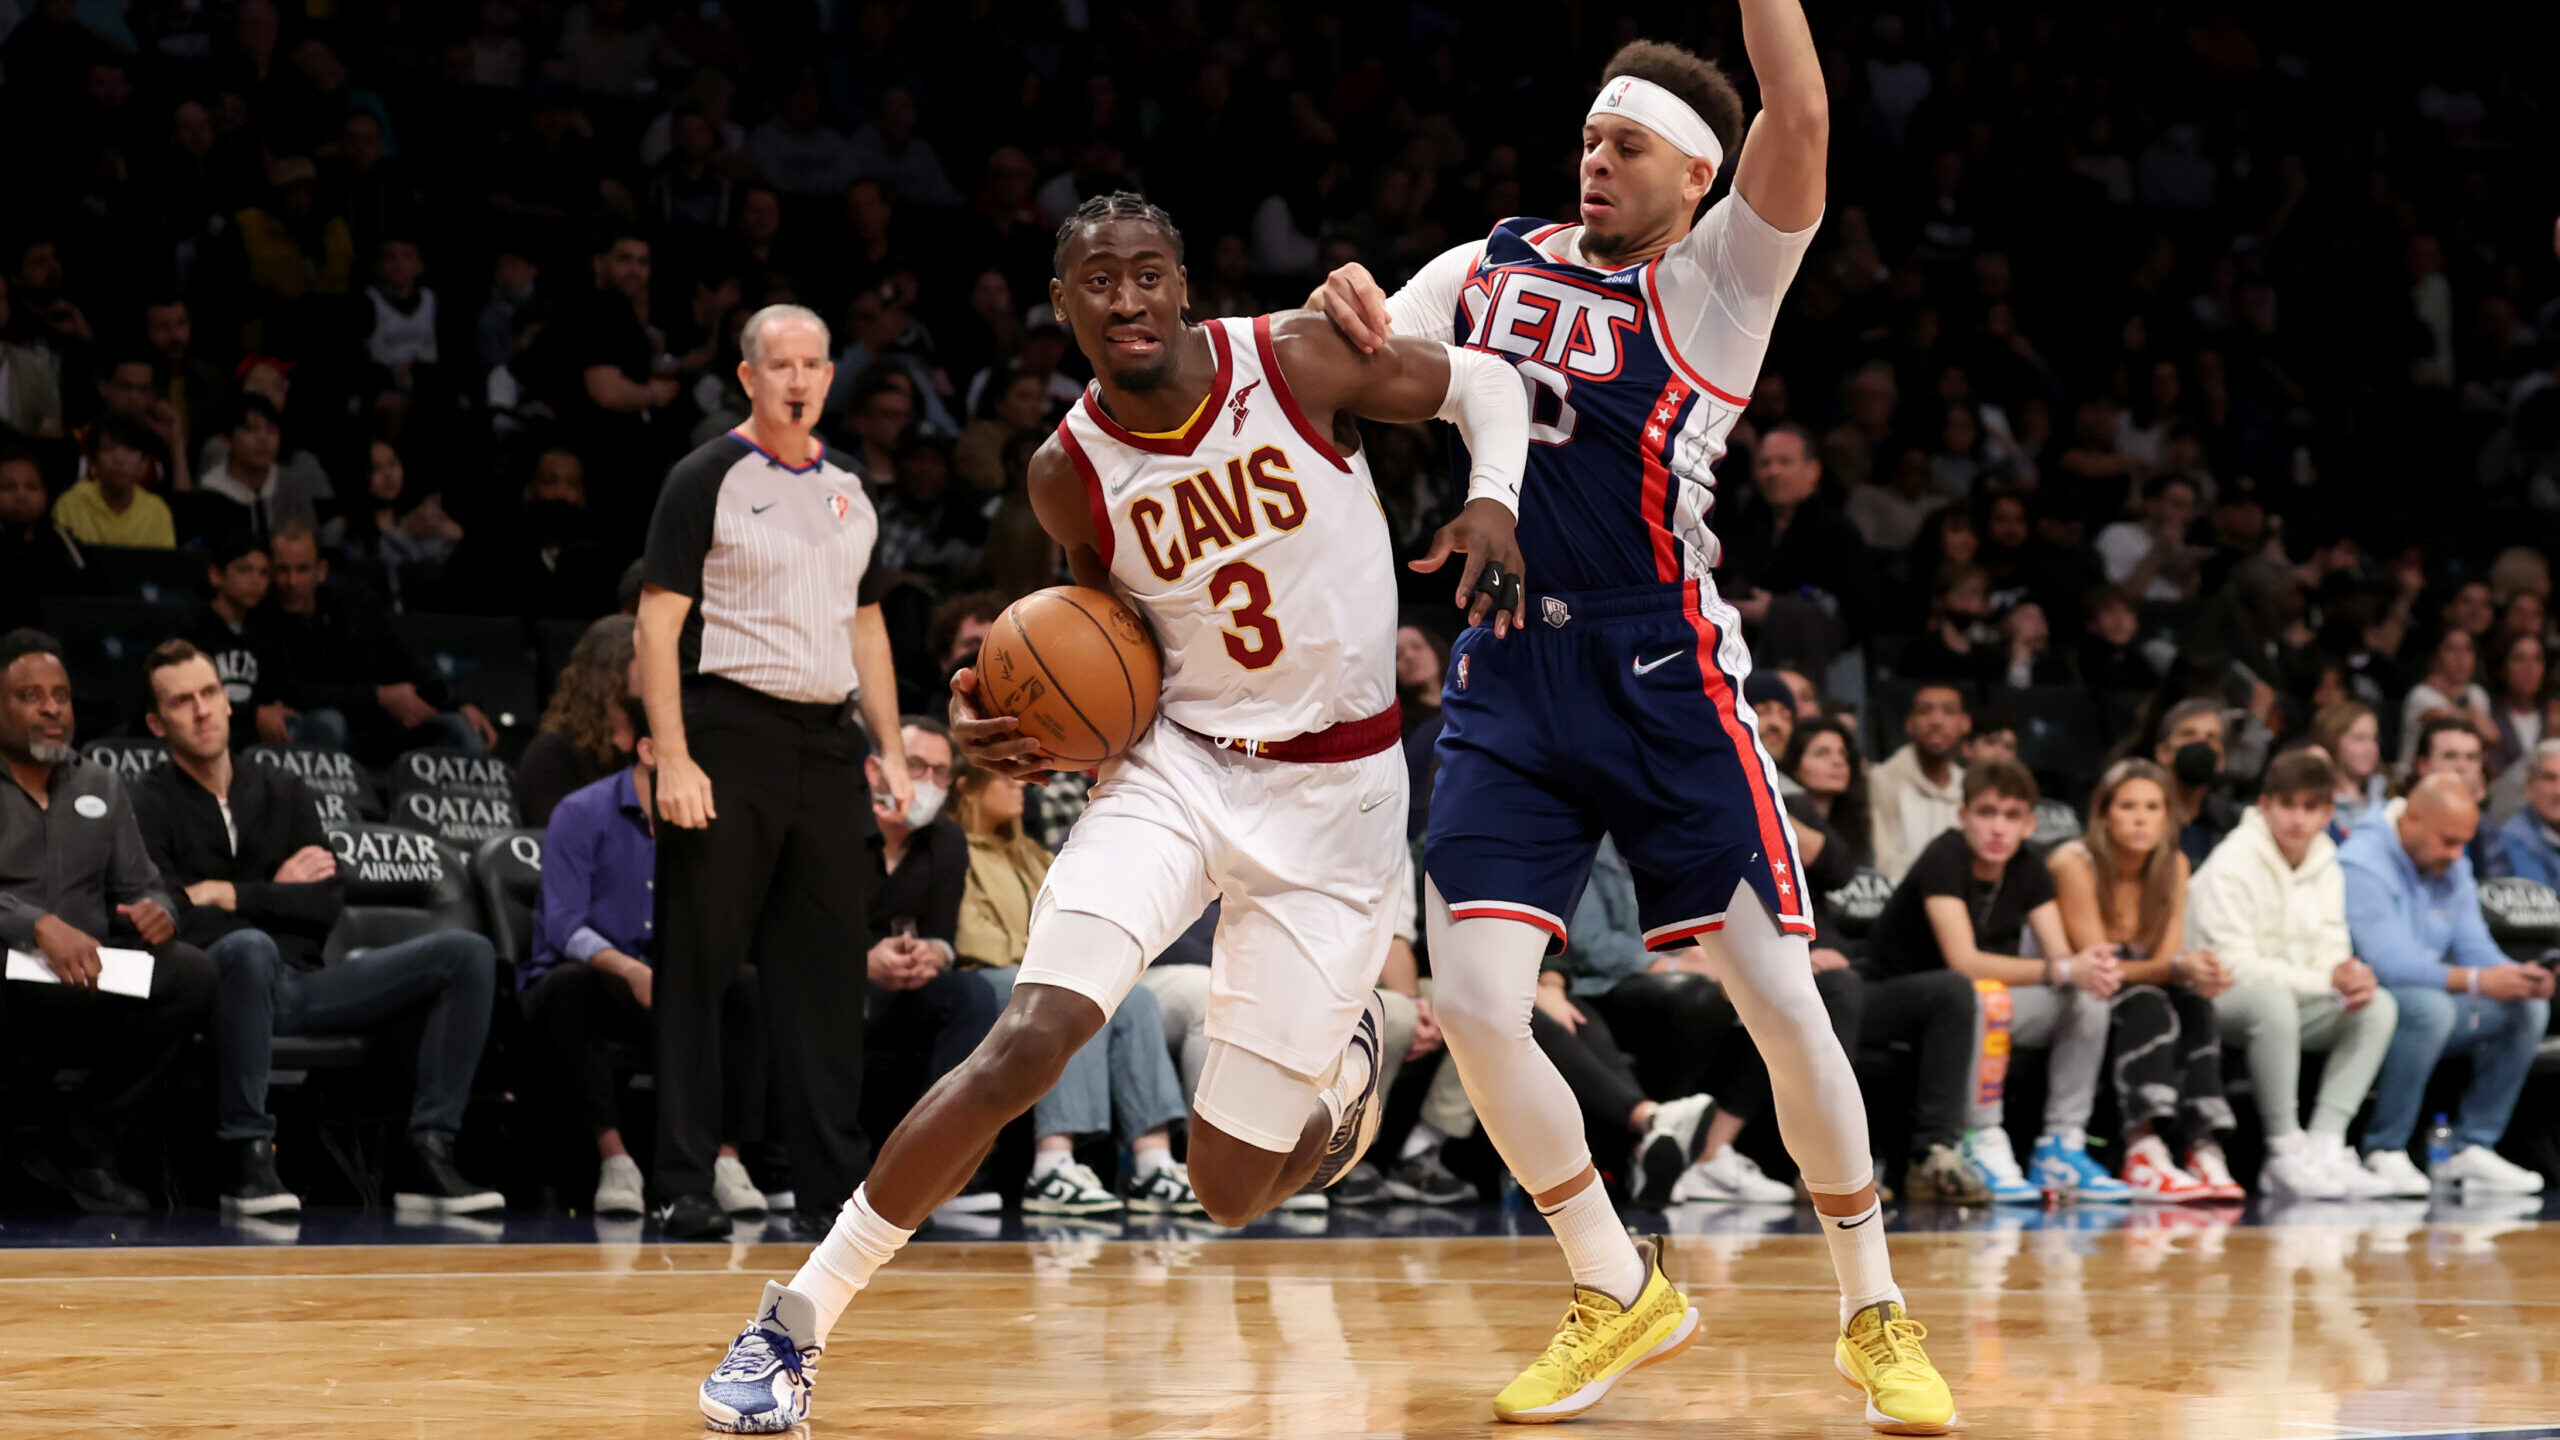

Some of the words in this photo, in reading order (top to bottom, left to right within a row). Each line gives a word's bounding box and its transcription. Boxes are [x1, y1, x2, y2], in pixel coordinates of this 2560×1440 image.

[1130, 445, 1308, 582] CAVS
[1208, 560, 1286, 672] 3
[410, 753, 508, 786] QATAR
[409, 793, 513, 826] QATAR
[328, 830, 440, 867] QATAR
[358, 861, 444, 882] AIRWAYS
